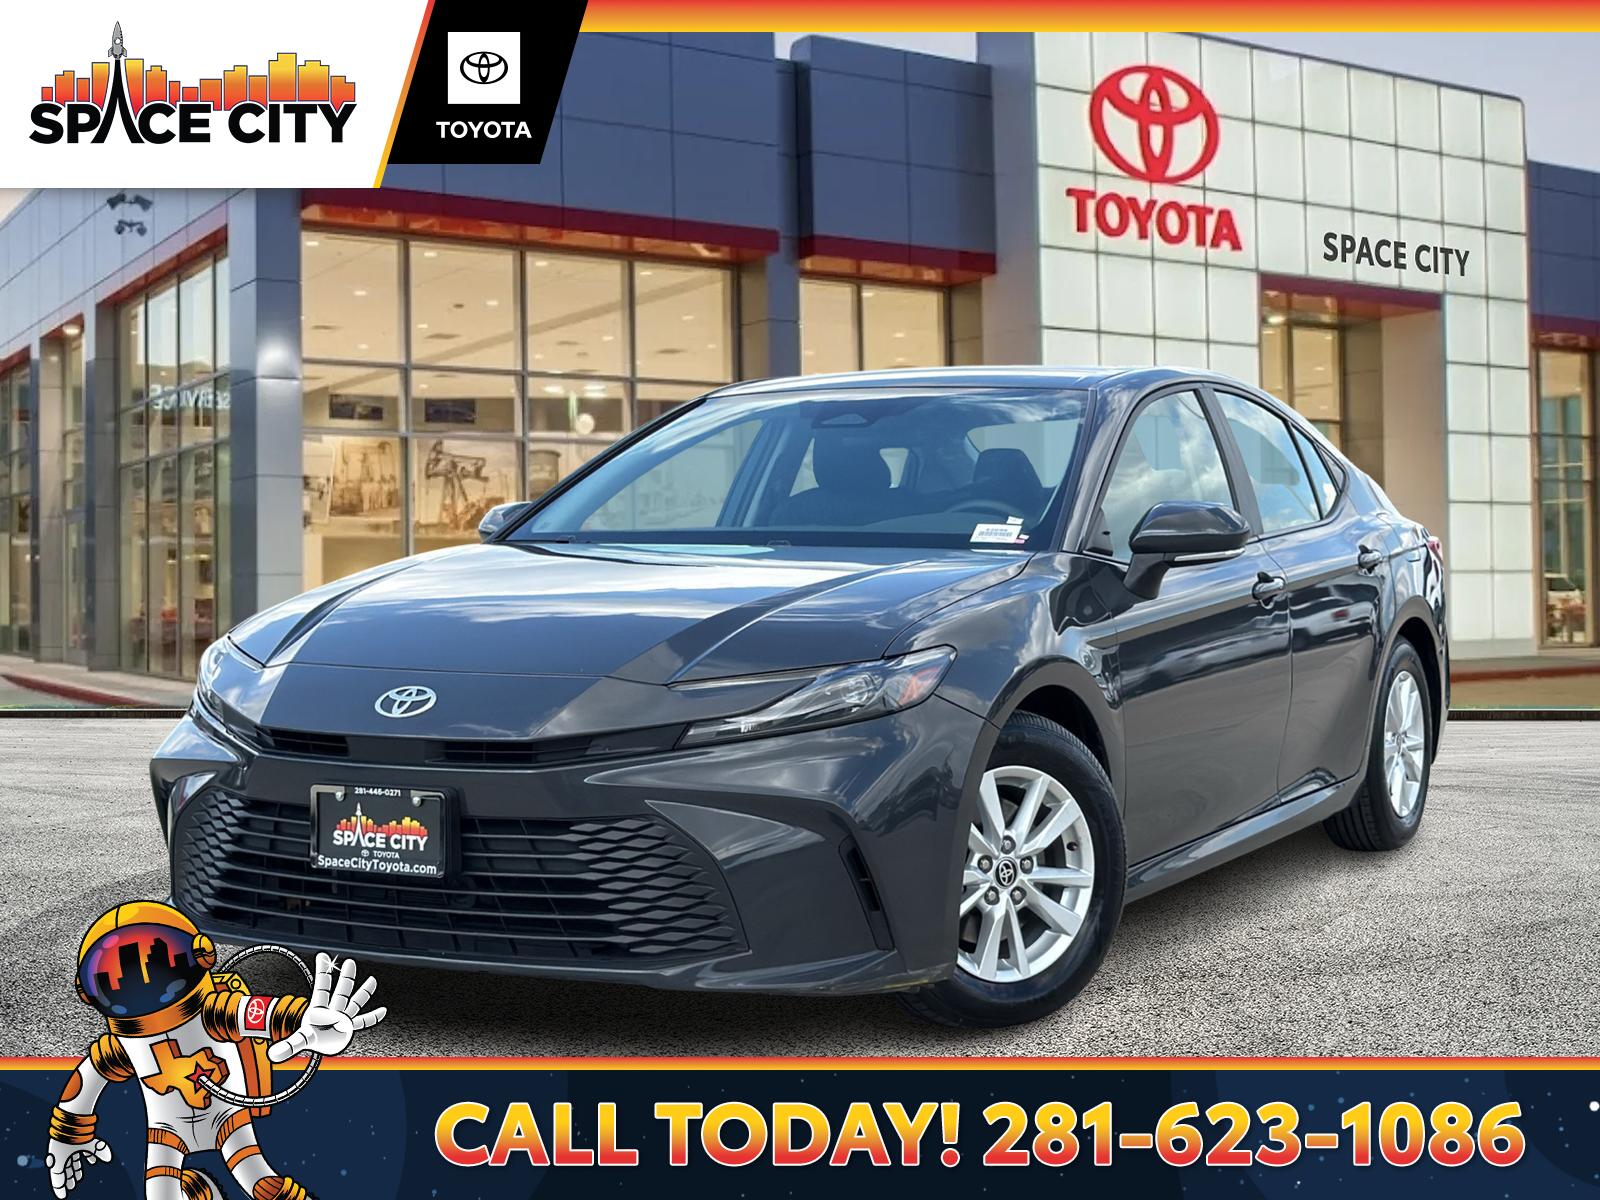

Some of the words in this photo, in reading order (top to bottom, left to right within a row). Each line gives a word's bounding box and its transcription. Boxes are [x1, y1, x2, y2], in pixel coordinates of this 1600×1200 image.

[1065, 187, 1243, 252] TOYOTA
[1322, 231, 1408, 271] SPACE
[1414, 244, 1471, 278] CITY
[332, 827, 387, 849] SPACE
[390, 833, 428, 851] CITY
[317, 854, 437, 875] SpaceCityToyota.com
[373, 850, 400, 859] TOYOTA
